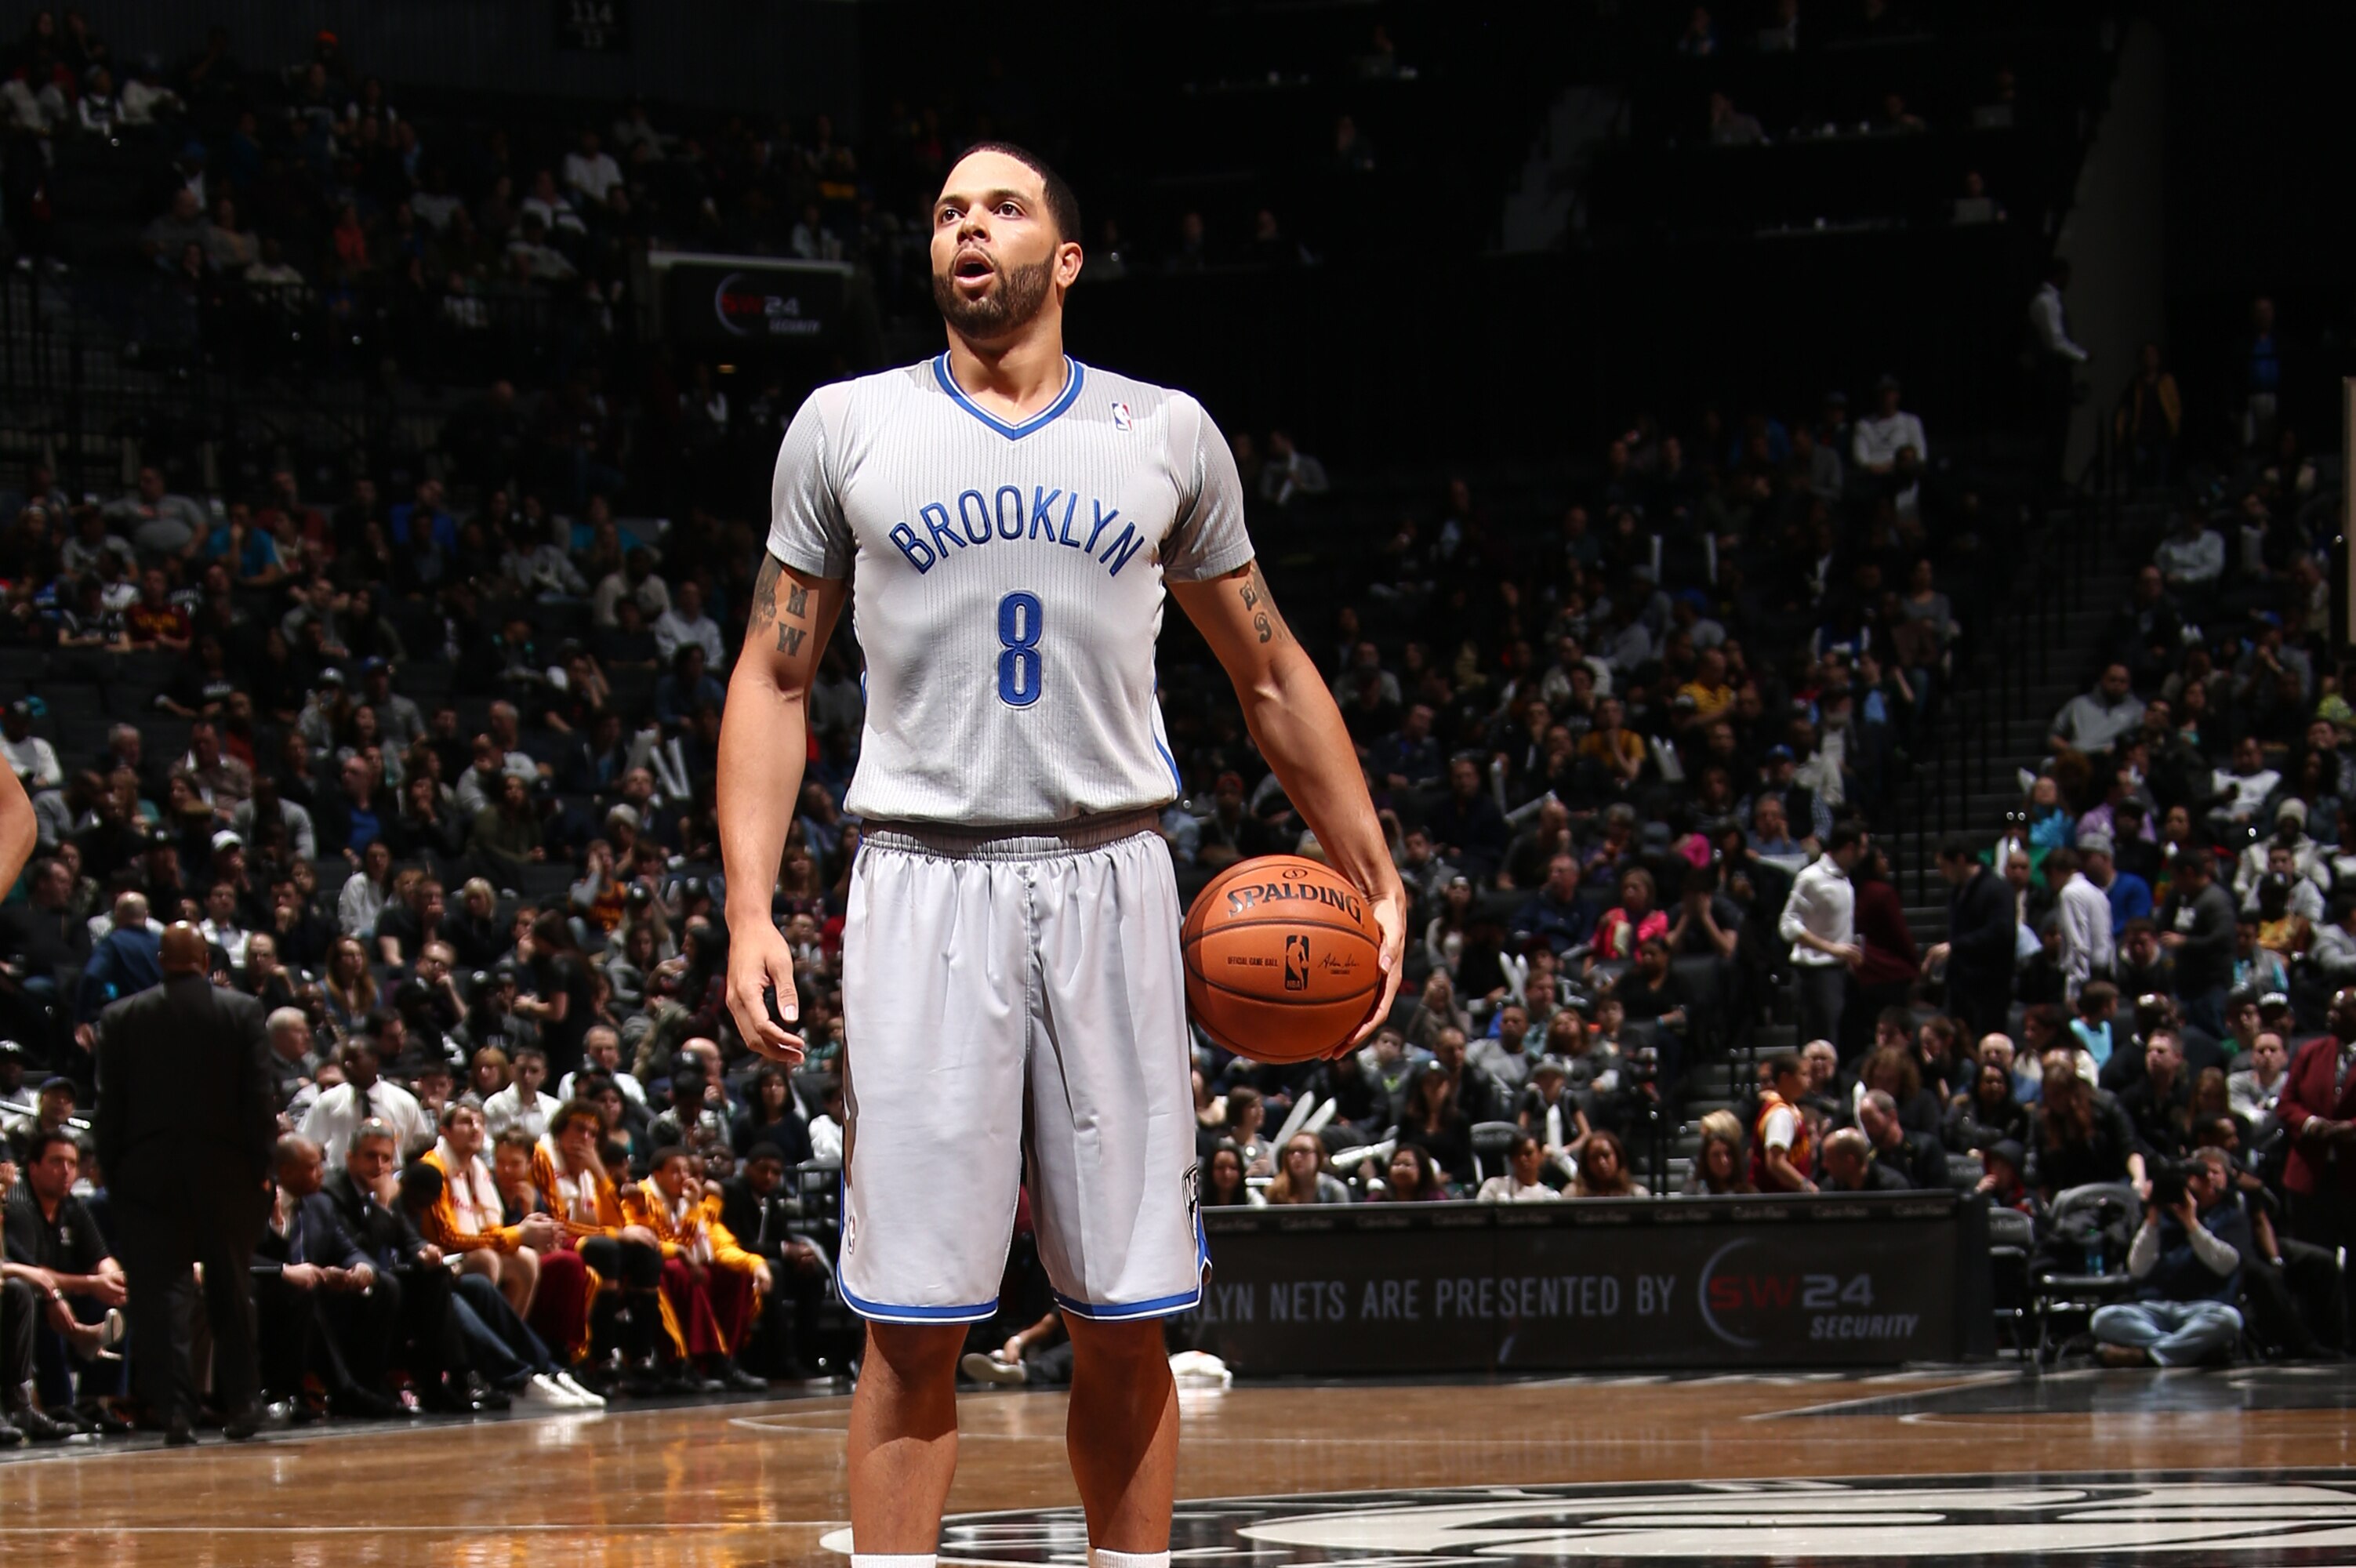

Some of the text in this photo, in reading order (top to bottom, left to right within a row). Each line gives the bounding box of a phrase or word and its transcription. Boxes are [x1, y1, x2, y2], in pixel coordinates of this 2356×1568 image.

[889, 485, 1145, 577] BROOKLYN
[997, 590, 1042, 707] 8
[1226, 883, 1362, 925] SPALDING
[1269, 1280, 1346, 1322] NETS
[1361, 1279, 1421, 1319] ARE
[1435, 1275, 1621, 1319] PRESENTED
[1636, 1274, 1677, 1316] BY
[1810, 1313, 1919, 1341] SECURITY
